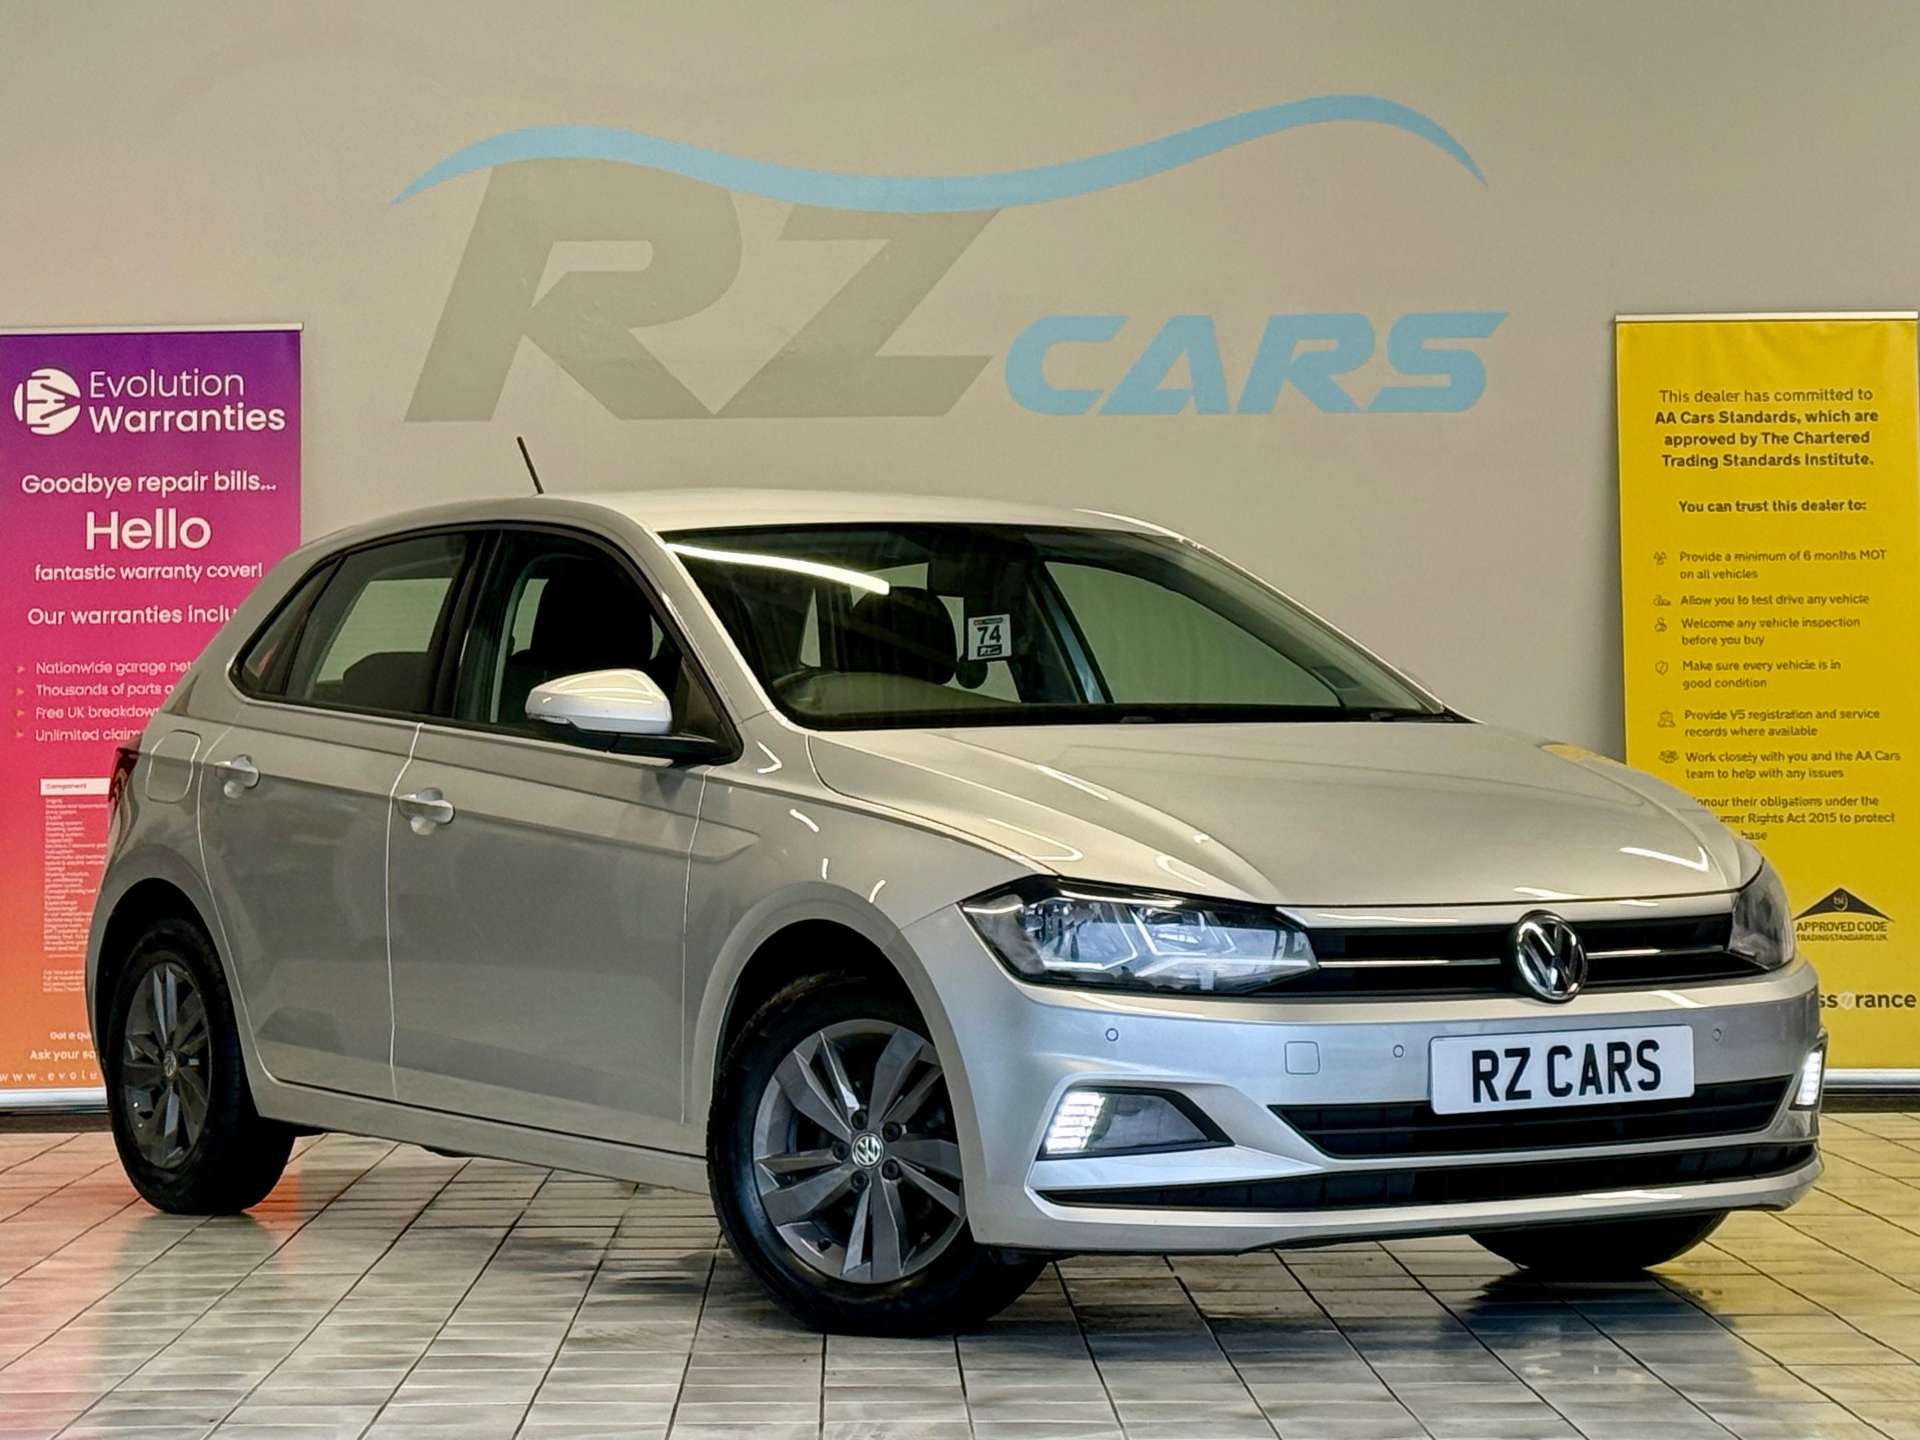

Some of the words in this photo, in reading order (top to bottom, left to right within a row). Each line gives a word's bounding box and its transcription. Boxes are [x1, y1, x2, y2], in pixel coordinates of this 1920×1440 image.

[404, 157, 1001, 422] RZ
[1005, 310, 1507, 416] CARS
[90, 367, 244, 398] Evolution
[1659, 390, 1689, 403] This
[1694, 389, 1739, 402] dealer
[1745, 389, 1770, 402] has
[1774, 388, 1853, 402] committed
[1858, 389, 1872, 400] to
[88, 402, 286, 433] Warranties
[1655, 411, 1676, 424] AA
[1680, 411, 1714, 424] Cars
[1718, 411, 1801, 424] Standards,
[1805, 410, 1850, 423] which
[1854, 411, 1879, 422] are
[1664, 432, 1736, 447] approved
[1740, 432, 1757, 447] by
[1761, 431, 1789, 445] The
[1793, 431, 1870, 444] Chartered
[1661, 454, 1718, 469] Trading
[1723, 453, 1800, 467] Standards
[1805, 452, 1874, 466] Institute.
[21, 473, 132, 499] Goodbye
[138, 471, 208, 498] repair
[214, 470, 277, 491] bills...
[1679, 501, 1703, 513] You
[1707, 502, 1732, 513] can
[1735, 501, 1768, 512] trust
[1772, 500, 1798, 512] this
[1801, 500, 1845, 511] dealer
[1848, 500, 1866, 511] to:
[86, 508, 212, 550] Hello
[1680, 551, 1721, 562] Provide
[1725, 553, 1732, 562] a
[1734, 551, 1786, 562] minimum
[1789, 550, 1801, 561] of
[1803, 550, 1811, 561] 6
[1814, 550, 1856, 561] months
[1859, 549, 1887, 560] MOT
[34, 564, 116, 582] fantastic
[120, 565, 202, 583] warranty
[206, 562, 263, 578] cover!
[1680, 570, 1694, 580] on
[1697, 568, 1710, 579] all
[1712, 568, 1758, 579] vehicles
[1680, 594, 1712, 606] Allow
[1714, 596, 1735, 607] you
[1737, 595, 1749, 605] to
[1752, 595, 1773, 605] test
[1776, 594, 1804, 605] drive
[1807, 595, 1828, 607] any
[1829, 593, 1869, 604] vehicle
[27, 608, 65, 625] Our
[71, 606, 182, 625] warranties
[1681, 618, 1734, 629] Welcome
[1737, 619, 1757, 631] any
[1760, 618, 1800, 628] vehicle
[1802, 617, 1860, 629] inspection
[977, 625, 1001, 644] 74
[1682, 635, 1718, 646] before
[1720, 636, 1741, 647] you
[1744, 635, 1765, 647] buy
[36, 661, 112, 675] Nationwide
[116, 662, 167, 677] garage
[1682, 660, 1713, 672] Make
[1715, 661, 1740, 671] sure
[1743, 661, 1773, 673] every
[1776, 660, 1815, 670] vehicle
[1818, 660, 1828, 670] is
[1830, 659, 1841, 670] in
[36, 683, 108, 697] Thousands
[111, 683, 125, 696] of
[128, 684, 161, 698] parts
[1682, 679, 1712, 690] good
[1714, 678, 1767, 689] condition
[36, 707, 64, 719] Free
[67, 706, 84, 719] UK
[1684, 709, 1727, 721] Provide
[1730, 709, 1746, 720] V5
[1748, 708, 1813, 721] registration
[1815, 708, 1837, 720] and
[1840, 708, 1880, 720] service
[36, 728, 100, 742] Unlimited
[1684, 726, 1728, 737] records
[1730, 726, 1765, 737] where
[1767, 725, 1818, 737] available
[1685, 751, 1716, 763] Work
[1718, 751, 1758, 765] closely
[1760, 750, 1786, 762] with
[1788, 752, 1808, 764] you
[1811, 750, 1832, 761] and
[1835, 750, 1853, 761] the
[1856, 750, 1872, 761] AA
[1874, 750, 1901, 761] Cars
[1686, 769, 1714, 779] team
[1717, 769, 1729, 779] to
[1731, 768, 1753, 781] help
[1759, 768, 1783, 778] with
[1785, 769, 1806, 780] any
[1808, 767, 1844, 778] issues
[1695, 797, 1729, 807] onour
[1731, 796, 1758, 807] their
[1760, 796, 1823, 808] obligations
[1825, 796, 1858, 807] under
[1861, 795, 1879, 806] the
[1748, 813, 1784, 825] Rights
[1786, 813, 1807, 824] Act
[1809, 812, 1836, 823] 2015
[1839, 813, 1851, 823] to
[1854, 812, 1895, 825] protect
[1796, 921, 1855, 932] APPROVED
[1857, 921, 1888, 932] CODE
[30, 1049, 51, 1060] Ask
[53, 1050, 80, 1062] your
[1472, 1047, 1532, 1103] RZ
[1547, 1040, 1661, 1098] CARS
